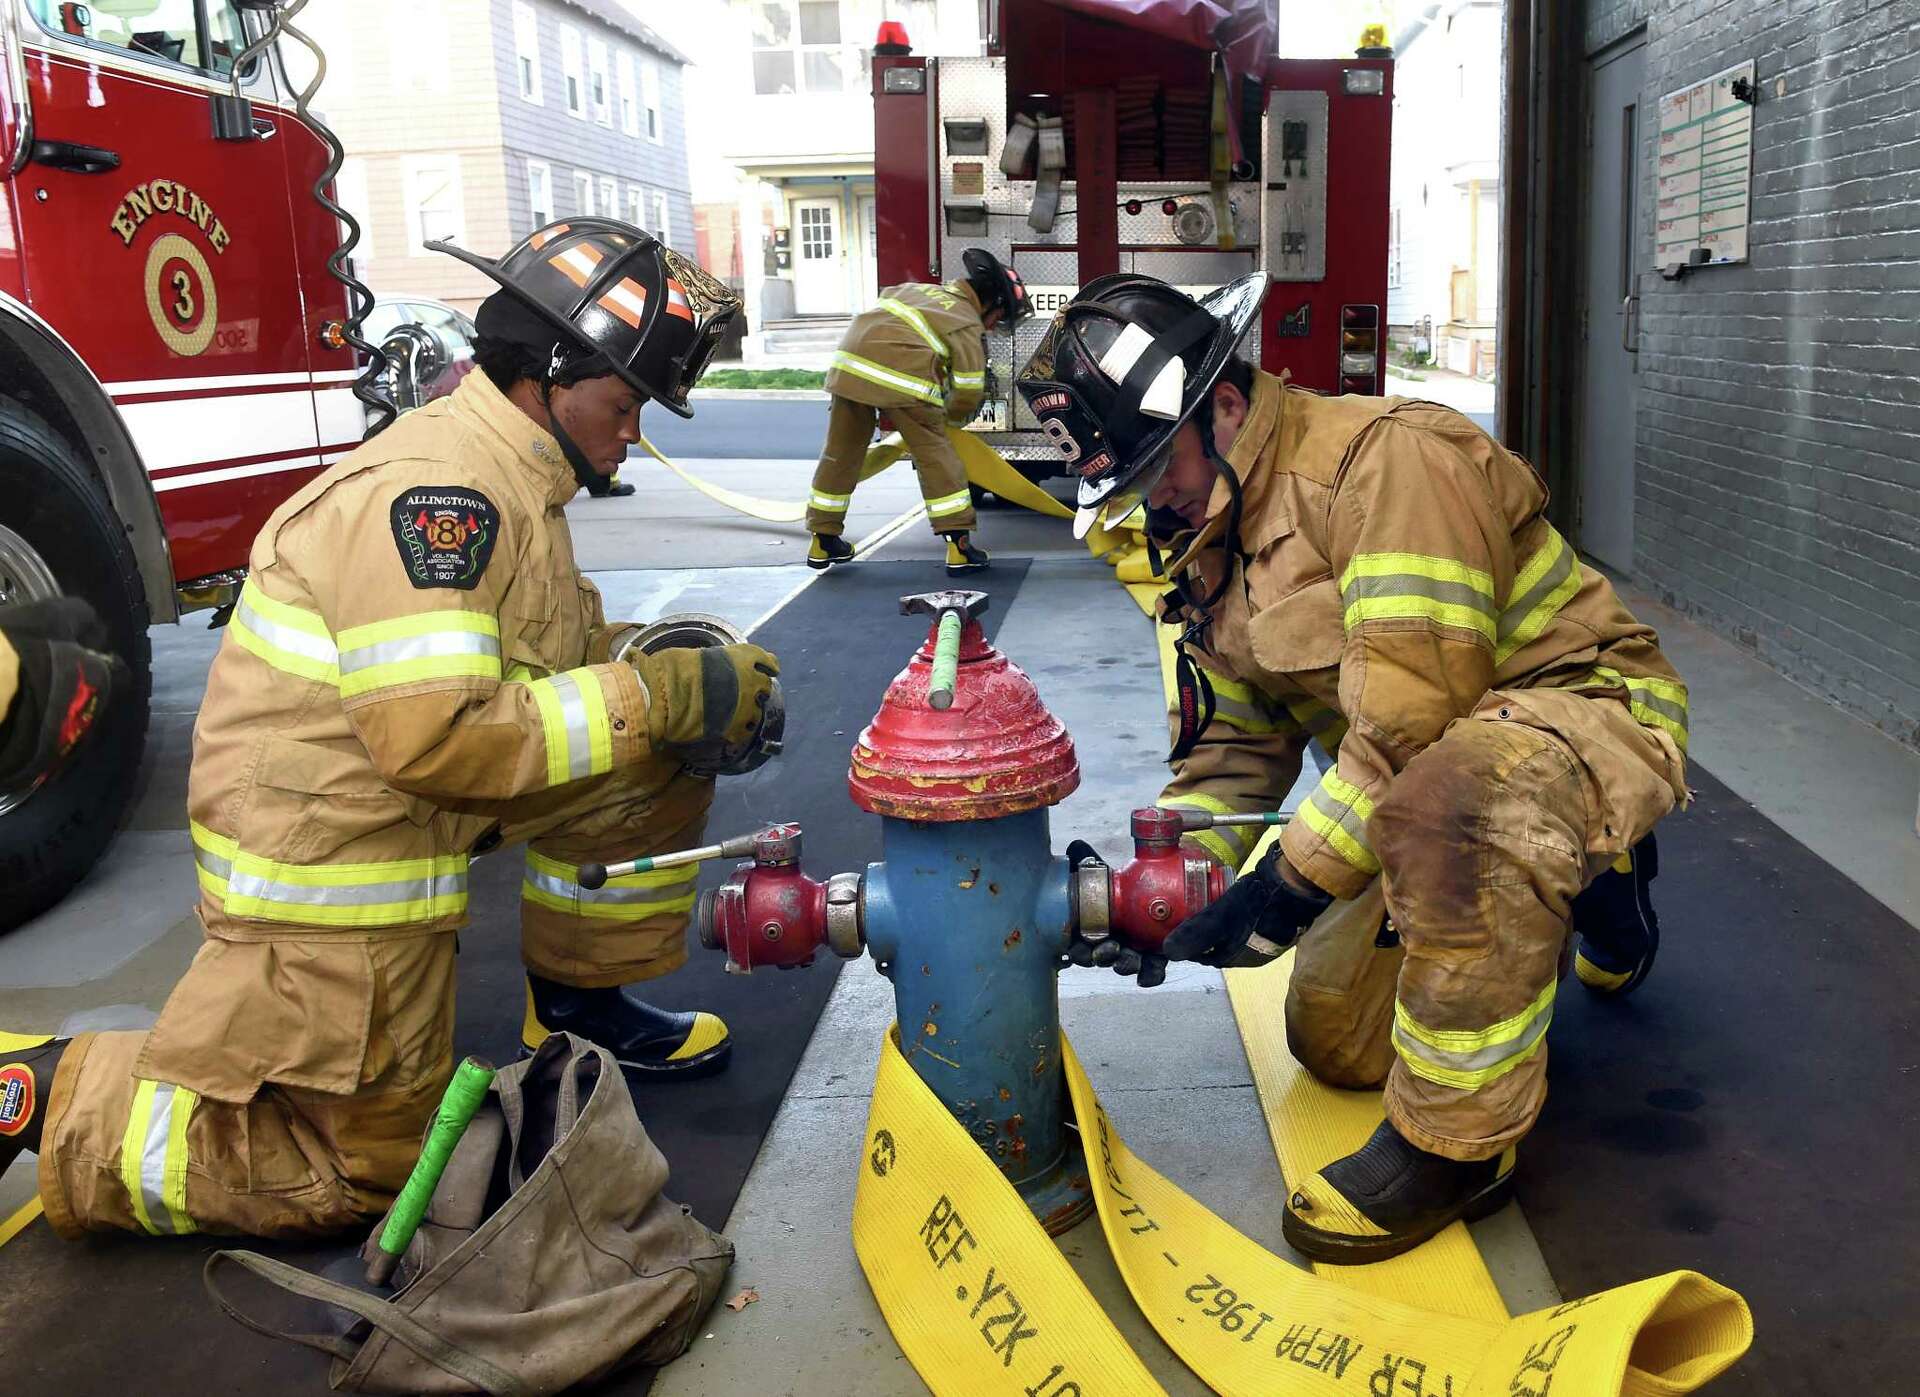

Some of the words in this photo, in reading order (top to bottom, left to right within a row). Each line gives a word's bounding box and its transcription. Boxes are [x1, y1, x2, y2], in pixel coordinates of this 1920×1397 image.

[111, 178, 231, 256] ENGINE
[172, 269, 195, 324] 3
[407, 495, 487, 511] ALLINGTOWN
[436, 519, 457, 544] 8
[434, 571, 456, 580] 1907
[3, 1082, 18, 1119] croydon
[1185, 1273, 1274, 1342] 1962
[1276, 1323, 1364, 1379] NFPA
